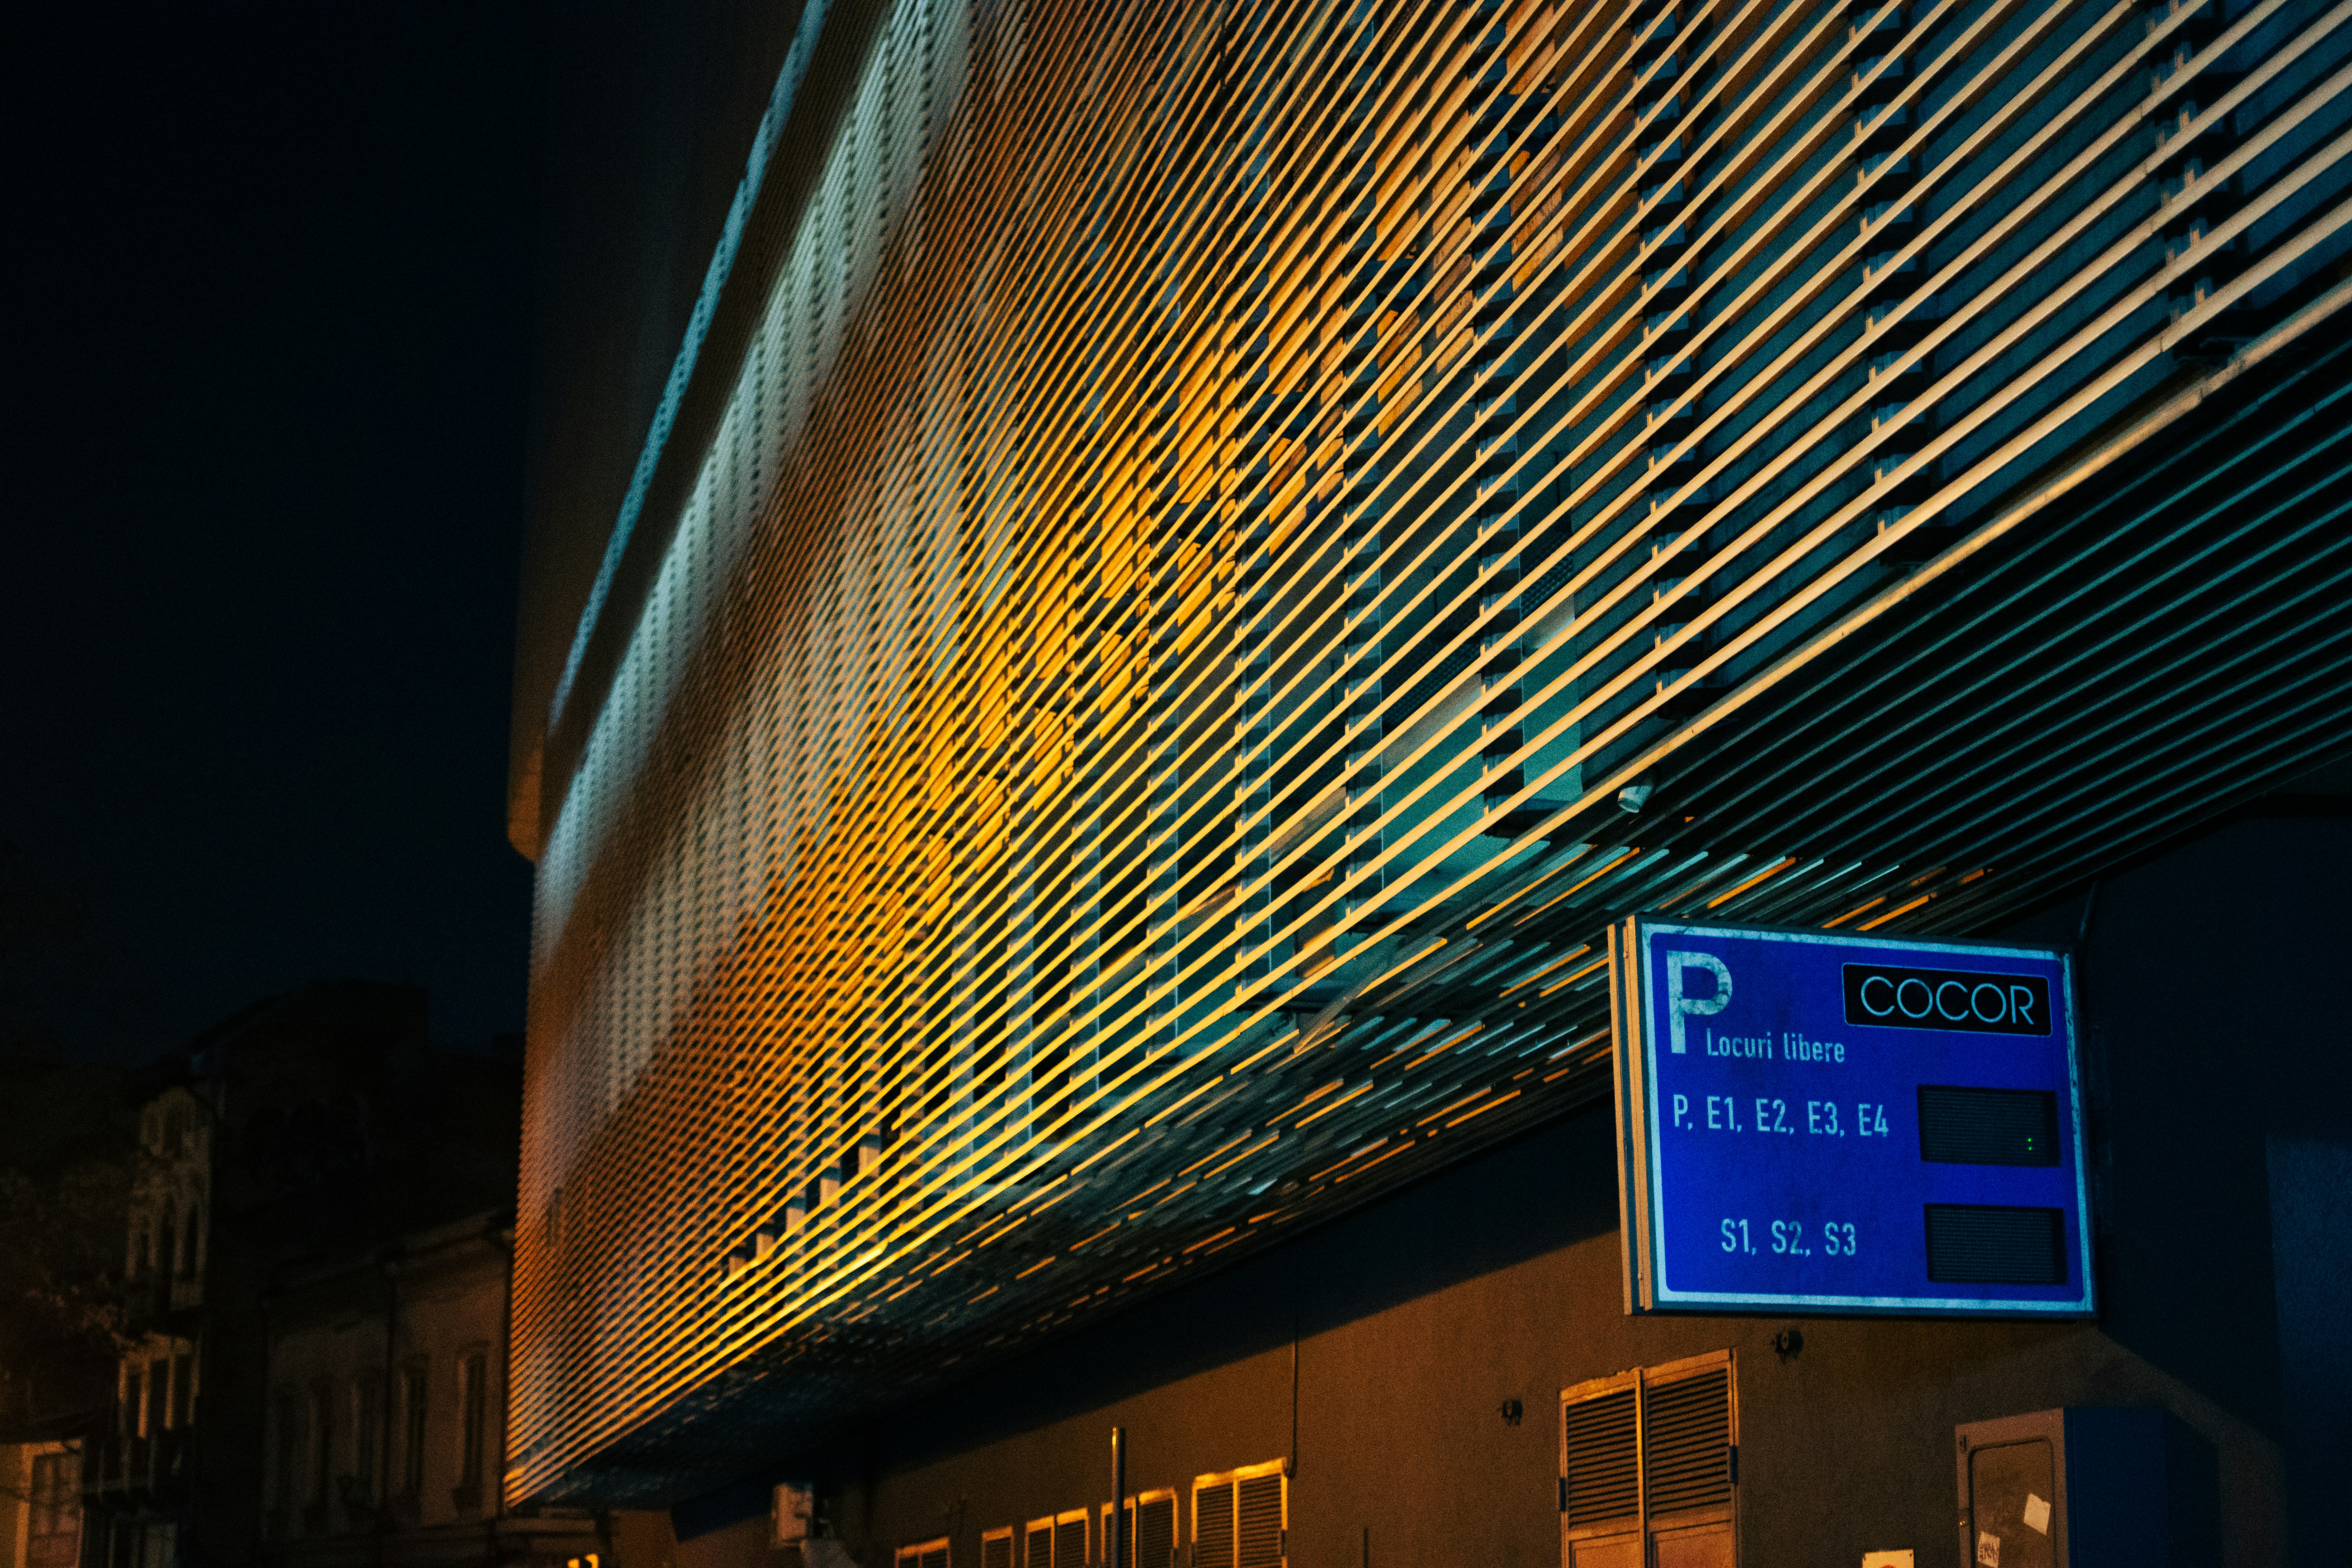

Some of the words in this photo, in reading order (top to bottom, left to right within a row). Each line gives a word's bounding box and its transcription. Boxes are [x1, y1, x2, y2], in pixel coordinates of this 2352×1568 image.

[1666, 950, 1733, 1054] P
[1860, 975, 2034, 1025] COCOR
[1706, 1027, 1773, 1059] Locuri
[1782, 1032, 1846, 1064] libere
[1706, 1094, 1743, 1133] E1,
[1755, 1097, 1795, 1135] E2,
[1807, 1100, 1846, 1138] E3,
[1857, 1102, 1889, 1138] E4
[1720, 1217, 1757, 1256] S1,
[1770, 1219, 1811, 1257] S2,
[1824, 1220, 1857, 1256] S3
